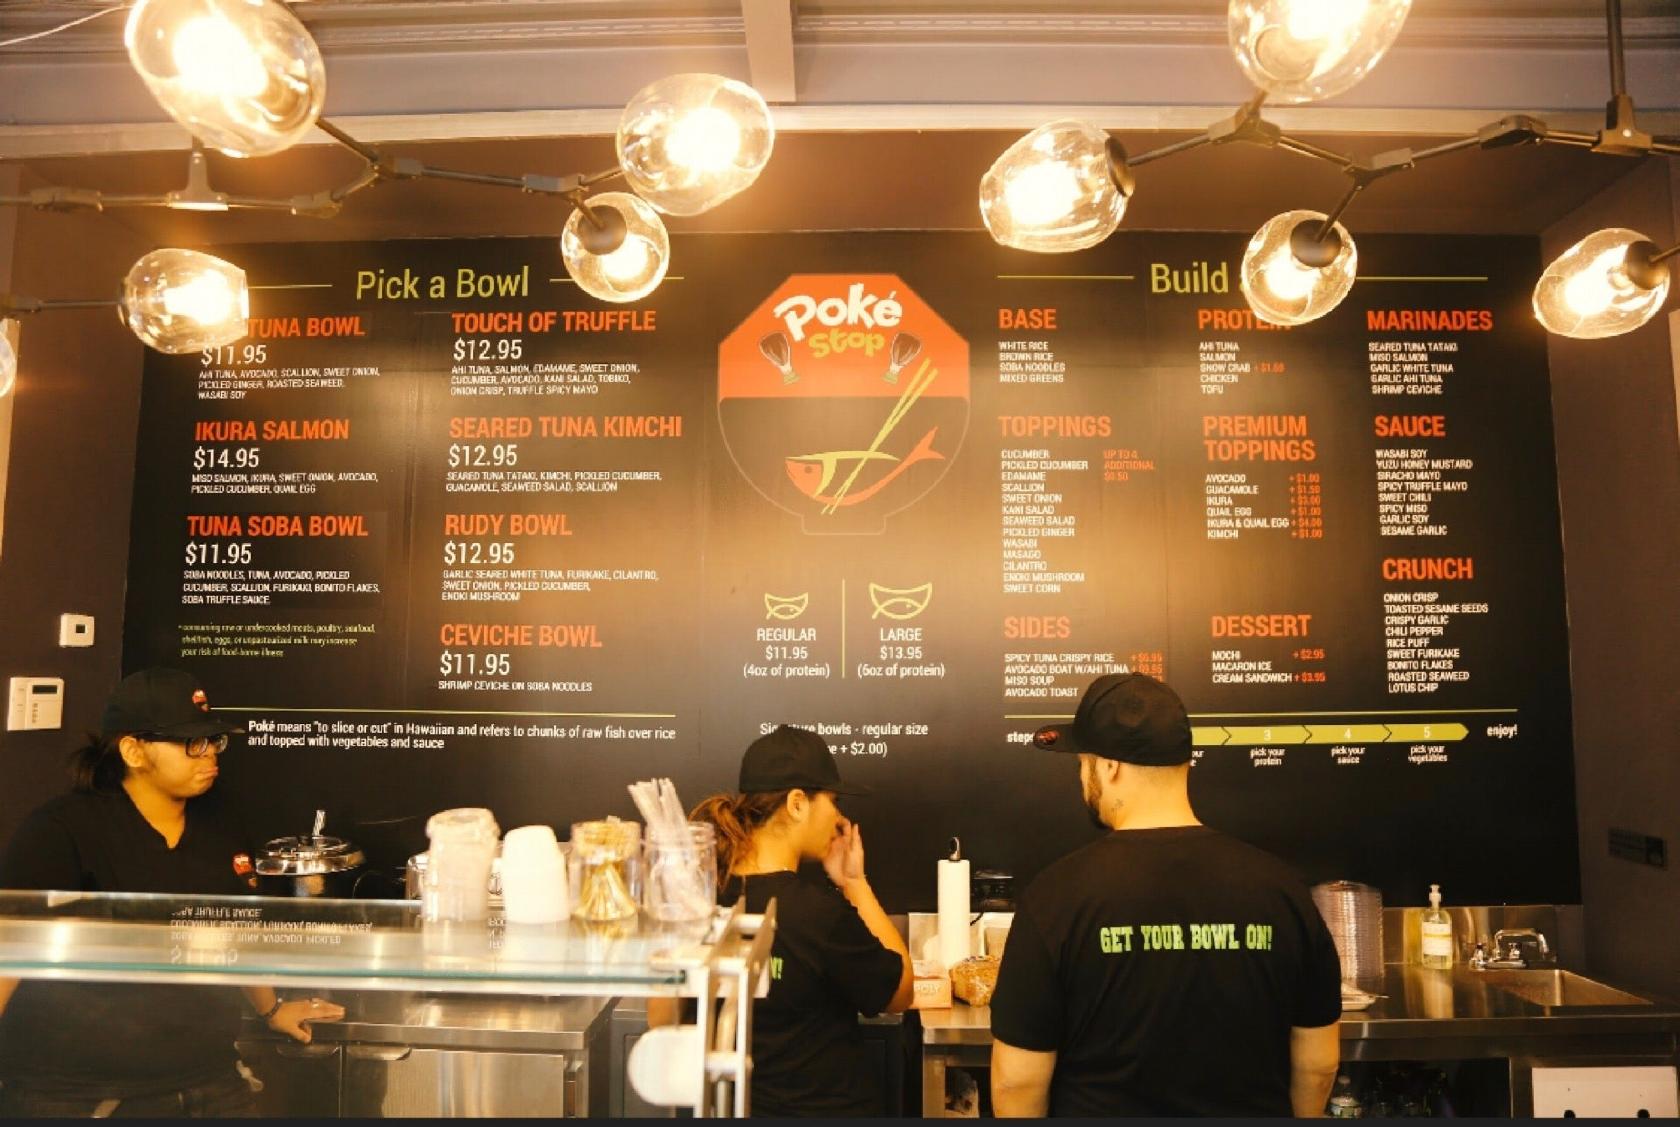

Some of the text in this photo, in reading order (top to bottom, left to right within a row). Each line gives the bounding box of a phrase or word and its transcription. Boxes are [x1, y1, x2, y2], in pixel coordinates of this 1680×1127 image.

[356, 265, 529, 300] Pick a Bowl
[1151, 261, 1228, 293] Build
[772, 282, 902, 341] Poké
[452, 311, 656, 333] TOUCH OF TRUFFLE
[999, 308, 1057, 329] BASE
[1198, 309, 1293, 330] PROT
[1367, 310, 1492, 331] MARINADES
[248, 316, 364, 338] TUNA BOWL
[453, 337, 522, 361] $12.95
[808, 327, 885, 358] stop
[999, 342, 1048, 350] WHITE RICE
[201, 344, 266, 366] $11.95
[999, 353, 1053, 361] BROWN RICE
[1000, 363, 1065, 372] SOBA NOODLES
[1370, 364, 1453, 373] GARLIC WHITE TUNA
[1201, 385, 1223, 394] TOFU
[1372, 385, 1442, 395] SHRIMP CEVICHE
[195, 419, 349, 442] IKURA SALMON
[450, 416, 682, 438] SEARED TUNA KIMCHI
[999, 415, 1111, 437] TOPPINGS
[1203, 416, 1306, 436] PREMIUM
[1375, 415, 1445, 437] SAUCE
[448, 444, 517, 467] $12.95
[1204, 440, 1316, 461] TOPPINGS
[194, 446, 260, 470] $14.95
[1205, 474, 1246, 483] AVOCADO
[1002, 483, 1044, 492] SCALLION
[1206, 485, 1259, 494] GUACAMOLE
[1378, 482, 1468, 491] SPICY TRUFFLE MAYO
[1207, 497, 1233, 505] IKURA
[187, 515, 368, 537] TUNA SOBA BOWL
[445, 515, 572, 535] RUDY BOWL
[1003, 516, 1075, 525] SEAWEED SALAD
[1003, 528, 1075, 536] PICKLED GINGER
[1208, 529, 1238, 539] KIMCHI
[1381, 526, 1447, 535] SESAME GARLIC
[1003, 539, 1037, 548] WASABI
[185, 541, 251, 566] $11.95
[444, 542, 515, 565] $12.95
[1004, 562, 1047, 570] CILANTRO
[1383, 558, 1473, 579] CRUNCH
[1384, 593, 1438, 602] ONION CRISP
[1004, 616, 1071, 638] SIDES
[1212, 615, 1311, 636] DESSERT
[1385, 616, 1448, 625] CRISPY GARLIC
[440, 624, 602, 647] CEVICHE BOWL
[757, 628, 816, 641] REGULAR
[880, 628, 922, 641] LARGE
[1386, 638, 1430, 648] RICE PUFF
[765, 646, 808, 660] $11.95
[880, 646, 922, 660] $13.95
[1005, 653, 1115, 662] SPICY TUNA CRISPY RICE
[1212, 651, 1240, 660] MOCHI
[1387, 649, 1460, 658] SWEET FURIKAKE
[440, 651, 510, 676] $11.95
[1212, 662, 1272, 671] MACARON ICE
[1387, 660, 1453, 669] BONITO FLAKES
[743, 663, 830, 678] (4oz of protein)
[858, 663, 945, 678] (6oz of protein)
[1389, 672, 1469, 681] ROASTED SEAWEED
[1005, 676, 1054, 685] MISO SOUP
[1212, 673, 1292, 683] CREAM SANDWICH
[439, 680, 592, 692] SHRIMP CEVICHE ON SOBA NOODLES
[1006, 688, 1078, 697] AVOCADO TOAST
[1389, 683, 1438, 693] LOTUS CHIP
[248, 720, 675, 740] Poké means "to slice or cut" in Hawaiian and refers to chunks of raw fish over rice
[818, 723, 851, 736] bowls
[862, 723, 901, 738] regular
[905, 723, 928, 738] size
[1263, 727, 1271, 741] 3
[1344, 727, 1351, 739] 4
[1424, 727, 1430, 738] 5
[1487, 724, 1517, 737] enjoy!
[248, 735, 444, 749] and topped with vegetables and sauce
[850, 742, 887, 757] $2.00)
[1251, 747, 1285, 759] pick your
[1332, 746, 1365, 757] pick your
[1411, 744, 1444, 756] pick your
[1254, 757, 1281, 767] protein
[1338, 756, 1359, 764] sauce
[1408, 753, 1447, 764] vegetables
[1101, 925, 1272, 953] GET YOUR BOWL ON!
